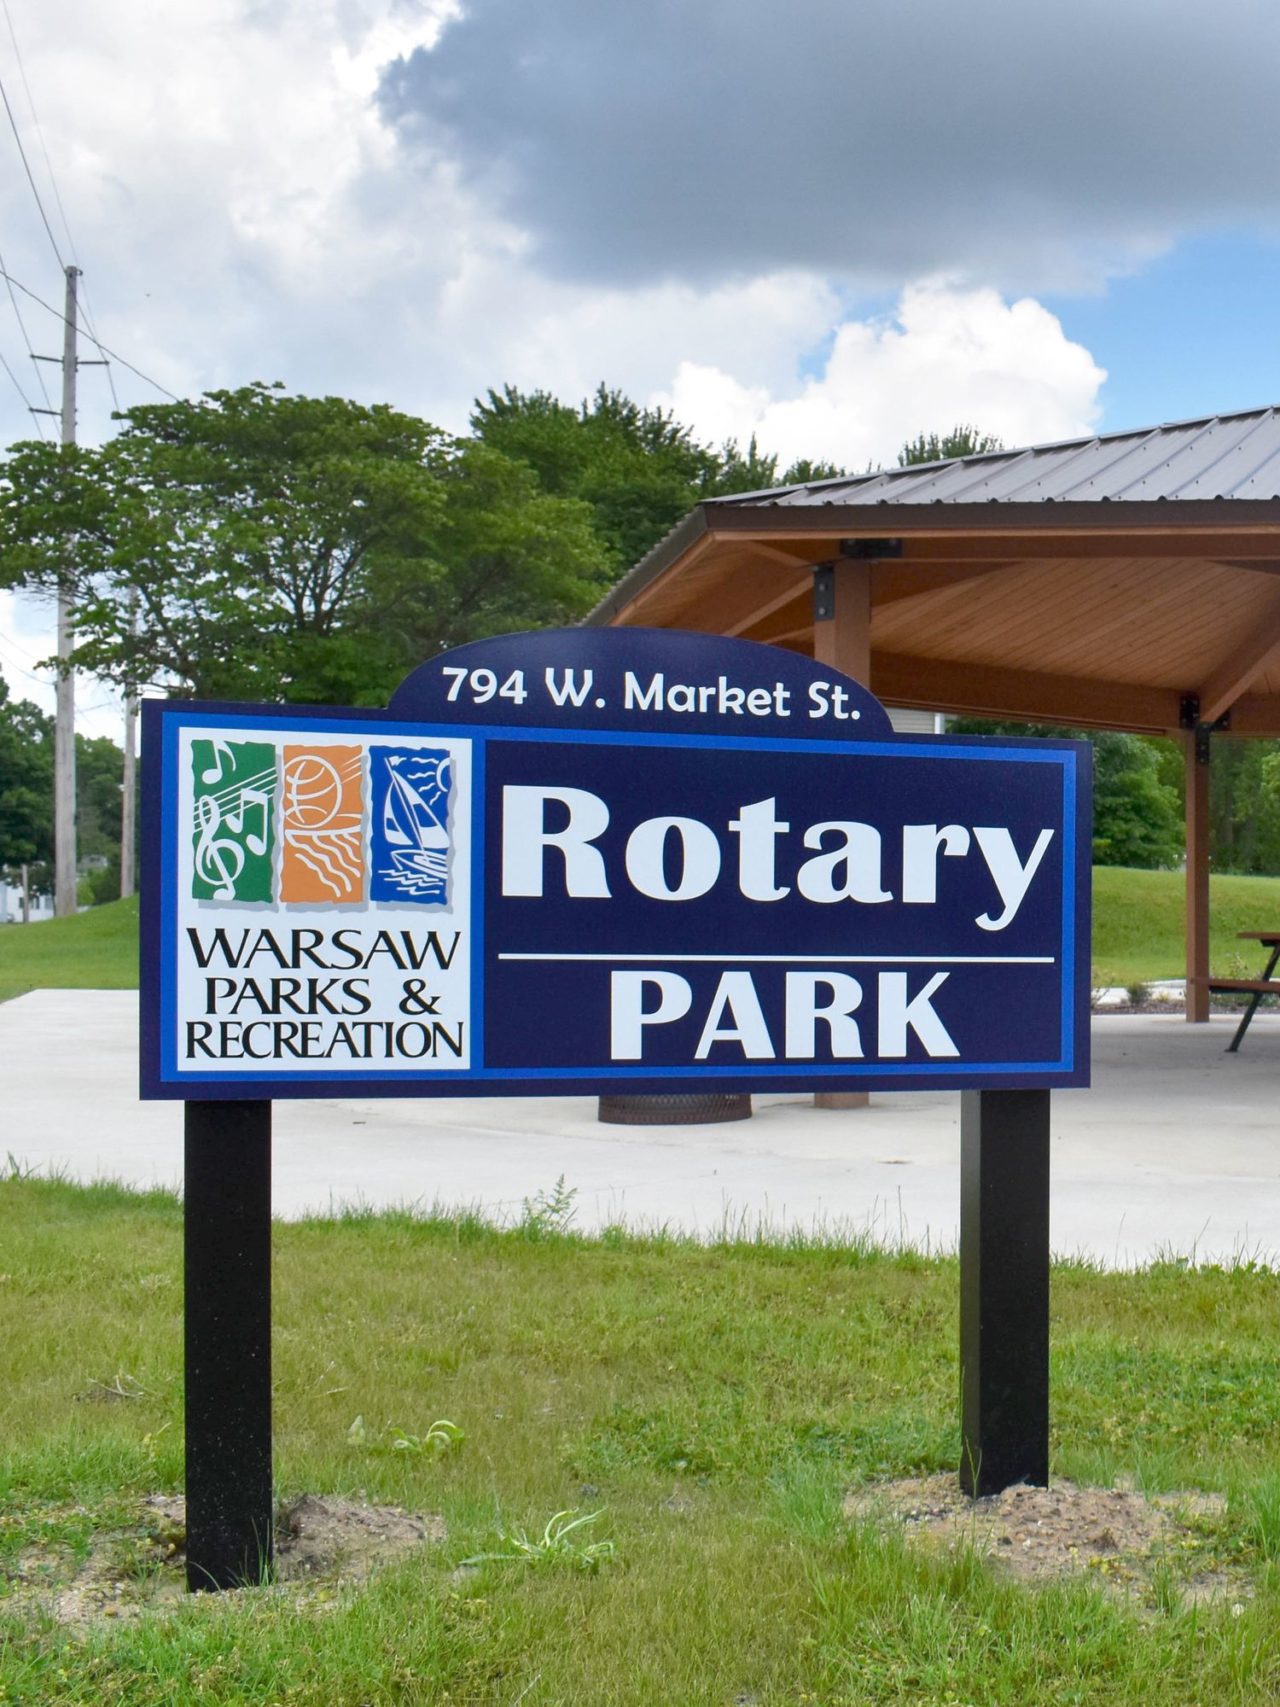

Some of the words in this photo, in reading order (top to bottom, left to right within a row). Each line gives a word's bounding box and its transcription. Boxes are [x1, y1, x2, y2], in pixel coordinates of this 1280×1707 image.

[442, 666, 528, 705] 794
[544, 667, 606, 709] W.
[624, 671, 791, 717] Market
[808, 681, 861, 721] St.
[501, 784, 1055, 932] Rotary
[186, 927, 462, 970] WARSAW
[205, 977, 372, 1016] PARKS
[398, 978, 441, 1016] &
[610, 970, 961, 1060] PARK
[186, 1021, 464, 1059] RECREATION
